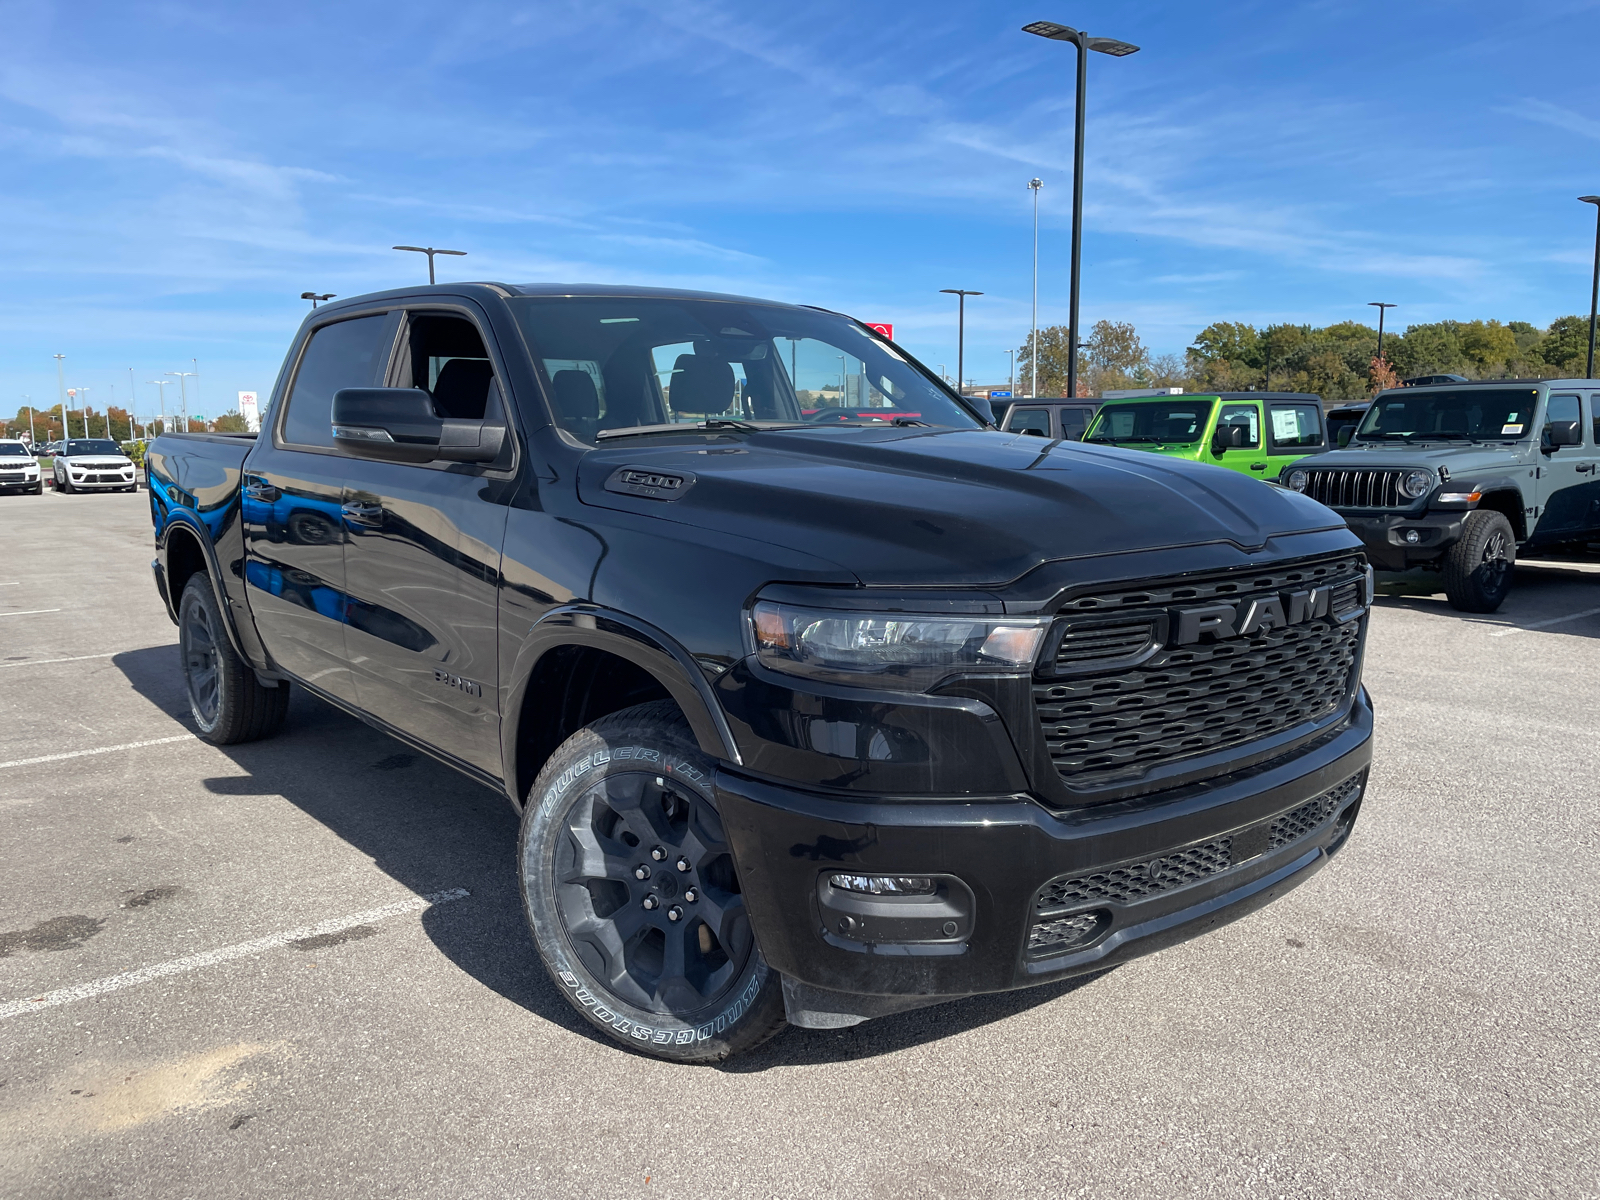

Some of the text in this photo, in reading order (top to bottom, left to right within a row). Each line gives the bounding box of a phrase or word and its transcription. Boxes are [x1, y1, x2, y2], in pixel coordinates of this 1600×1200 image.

[619, 470, 683, 490] 1500
[1174, 584, 1331, 646] RAM
[540, 745, 661, 819] DUELER
[558, 970, 761, 1046] BRIDGESTONE
